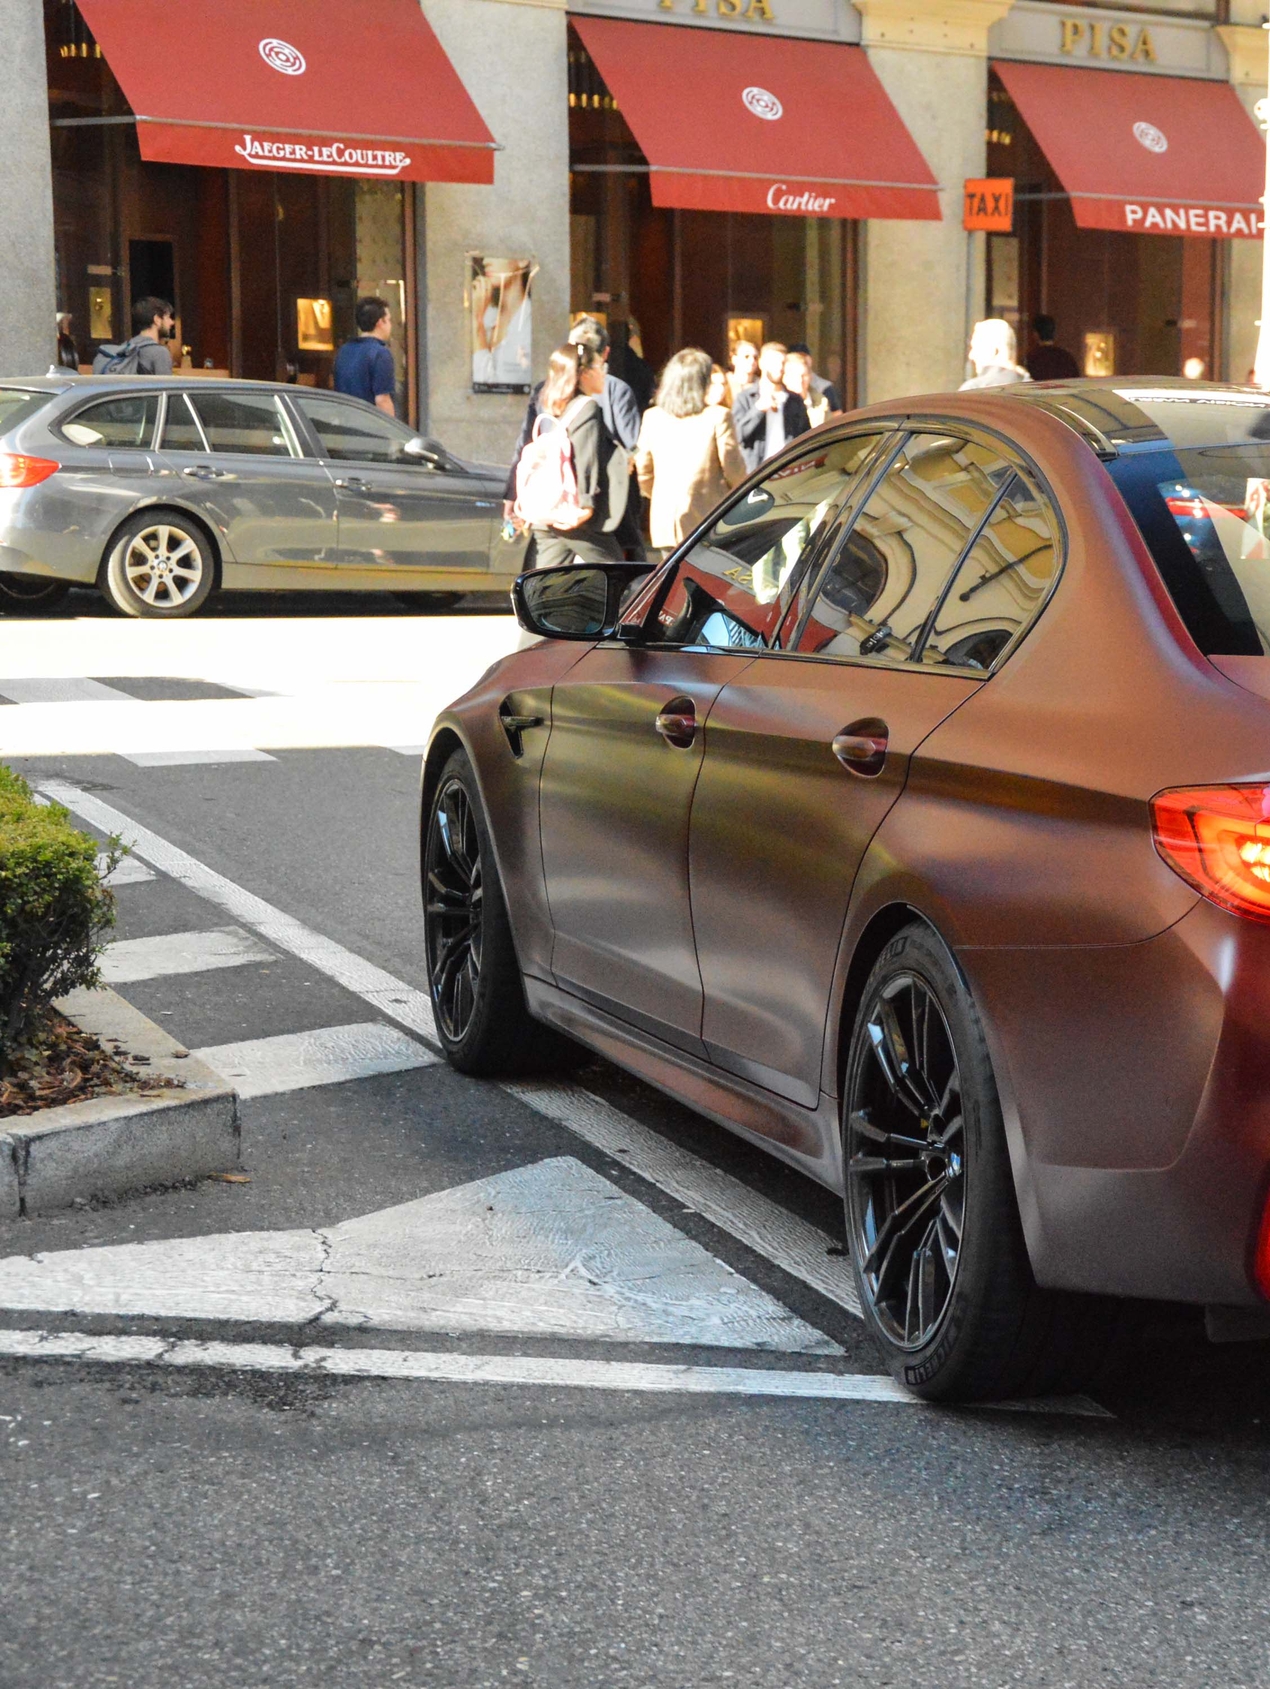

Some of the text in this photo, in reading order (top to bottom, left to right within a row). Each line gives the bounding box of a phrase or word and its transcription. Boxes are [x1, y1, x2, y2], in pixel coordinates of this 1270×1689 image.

[1060, 18, 1158, 62] PISA
[766, 183, 836, 213] Cartier
[966, 192, 1010, 217] TAXI
[1124, 204, 1258, 235] PANERAI
